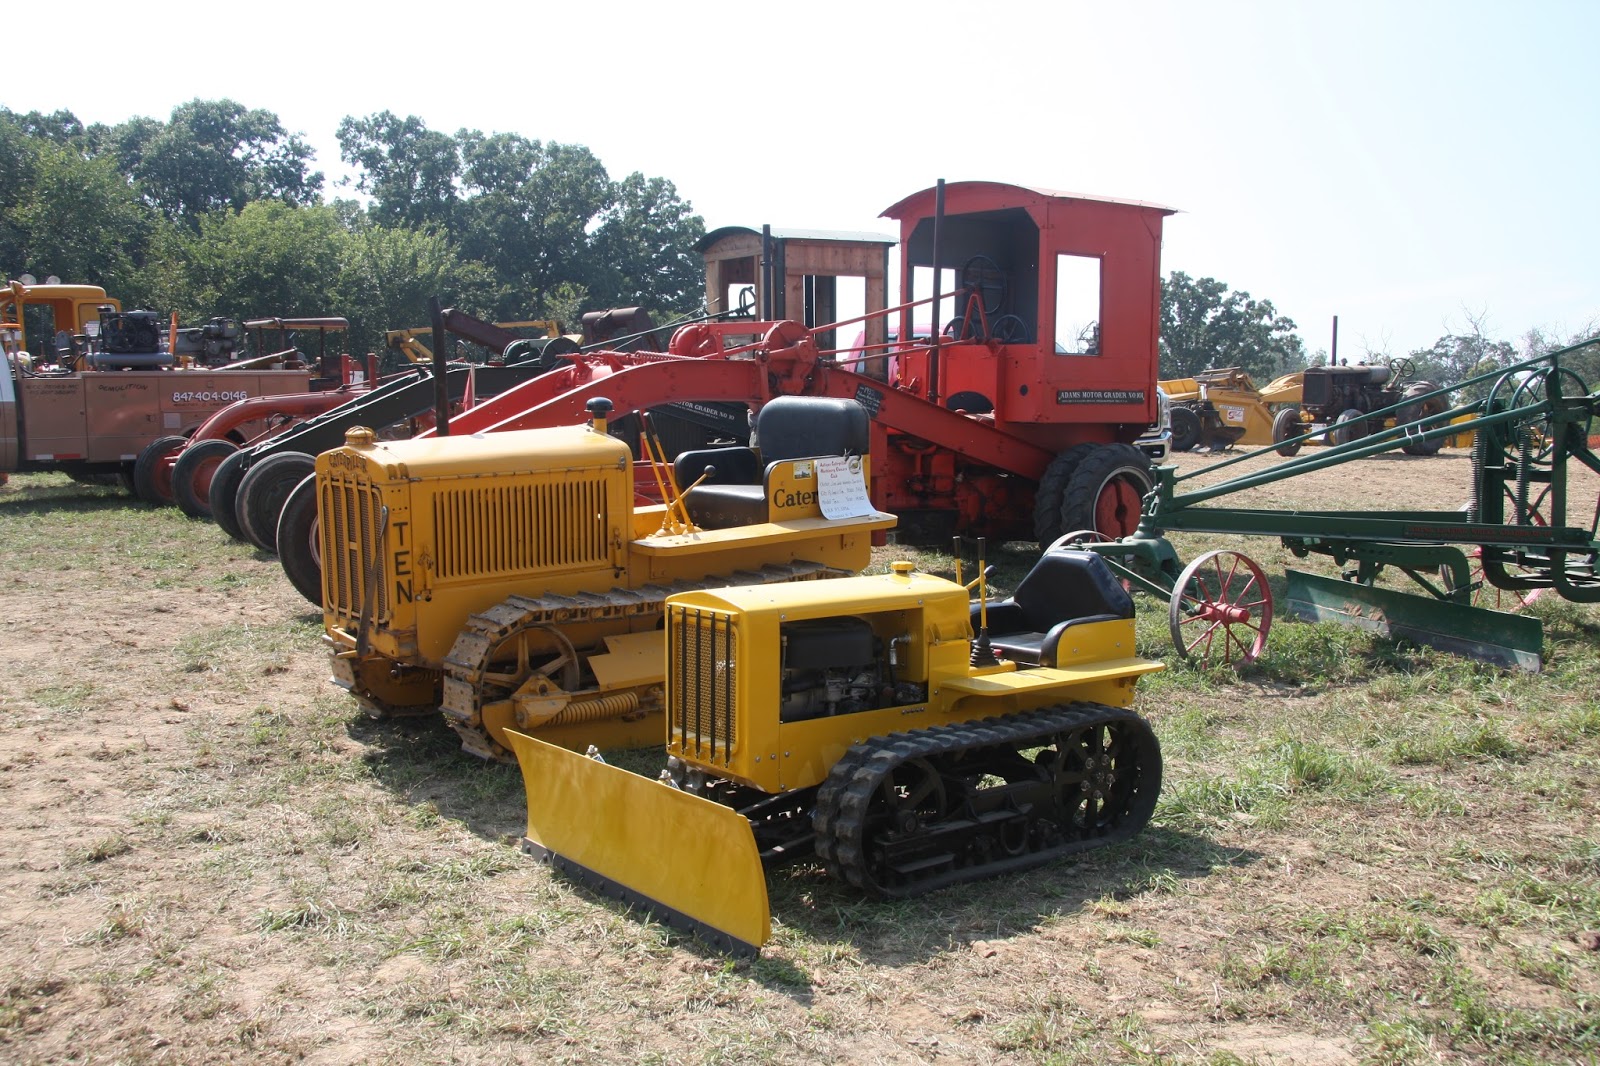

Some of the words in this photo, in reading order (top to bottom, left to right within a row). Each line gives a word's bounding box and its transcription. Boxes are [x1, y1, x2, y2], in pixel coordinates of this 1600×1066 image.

[98, 383, 148, 392] DEMOLITION
[1060, 391, 1080, 399] ADAMS
[1082, 391, 1103, 399] MOTOR
[1103, 391, 1127, 399] GRADER
[694, 404, 718, 416] GRADER
[392, 521, 413, 604] TEN
